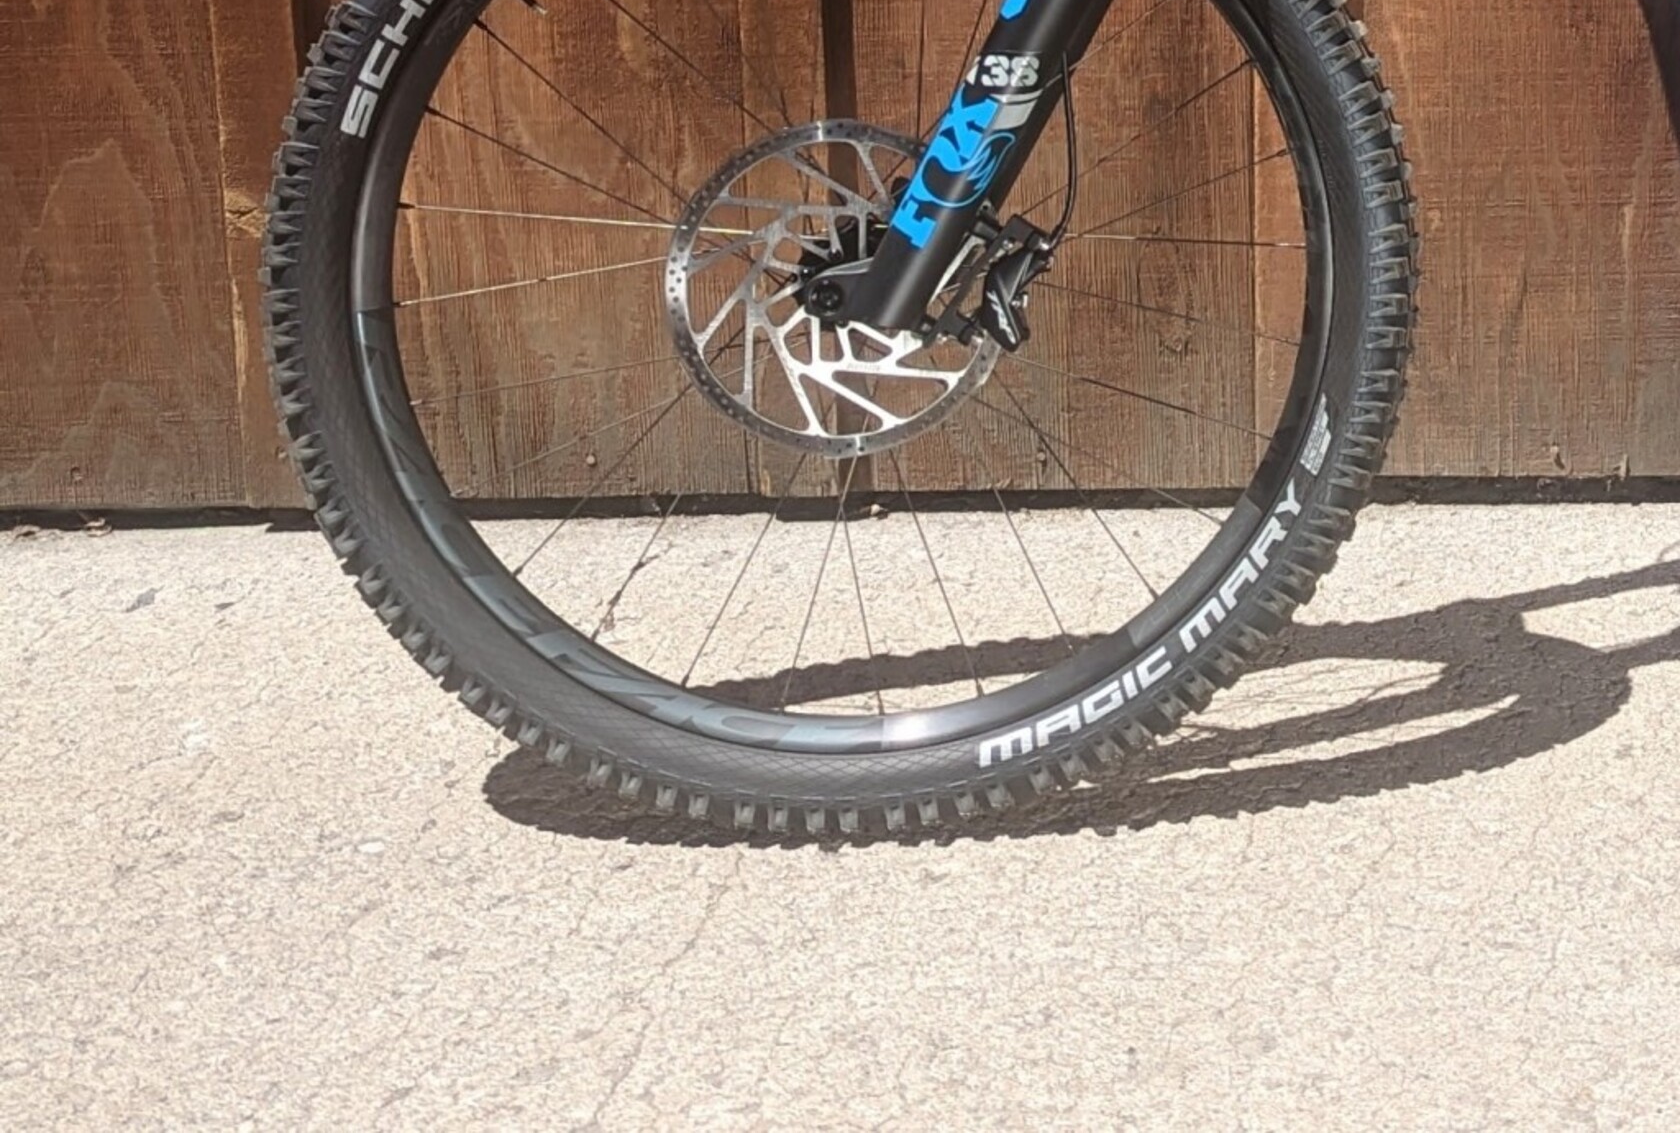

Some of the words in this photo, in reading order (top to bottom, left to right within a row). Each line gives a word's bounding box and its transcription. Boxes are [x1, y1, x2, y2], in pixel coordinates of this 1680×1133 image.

[890, 83, 1016, 249] FOX
[978, 646, 1173, 768] MAGIC
[1178, 478, 1302, 653] MARY
